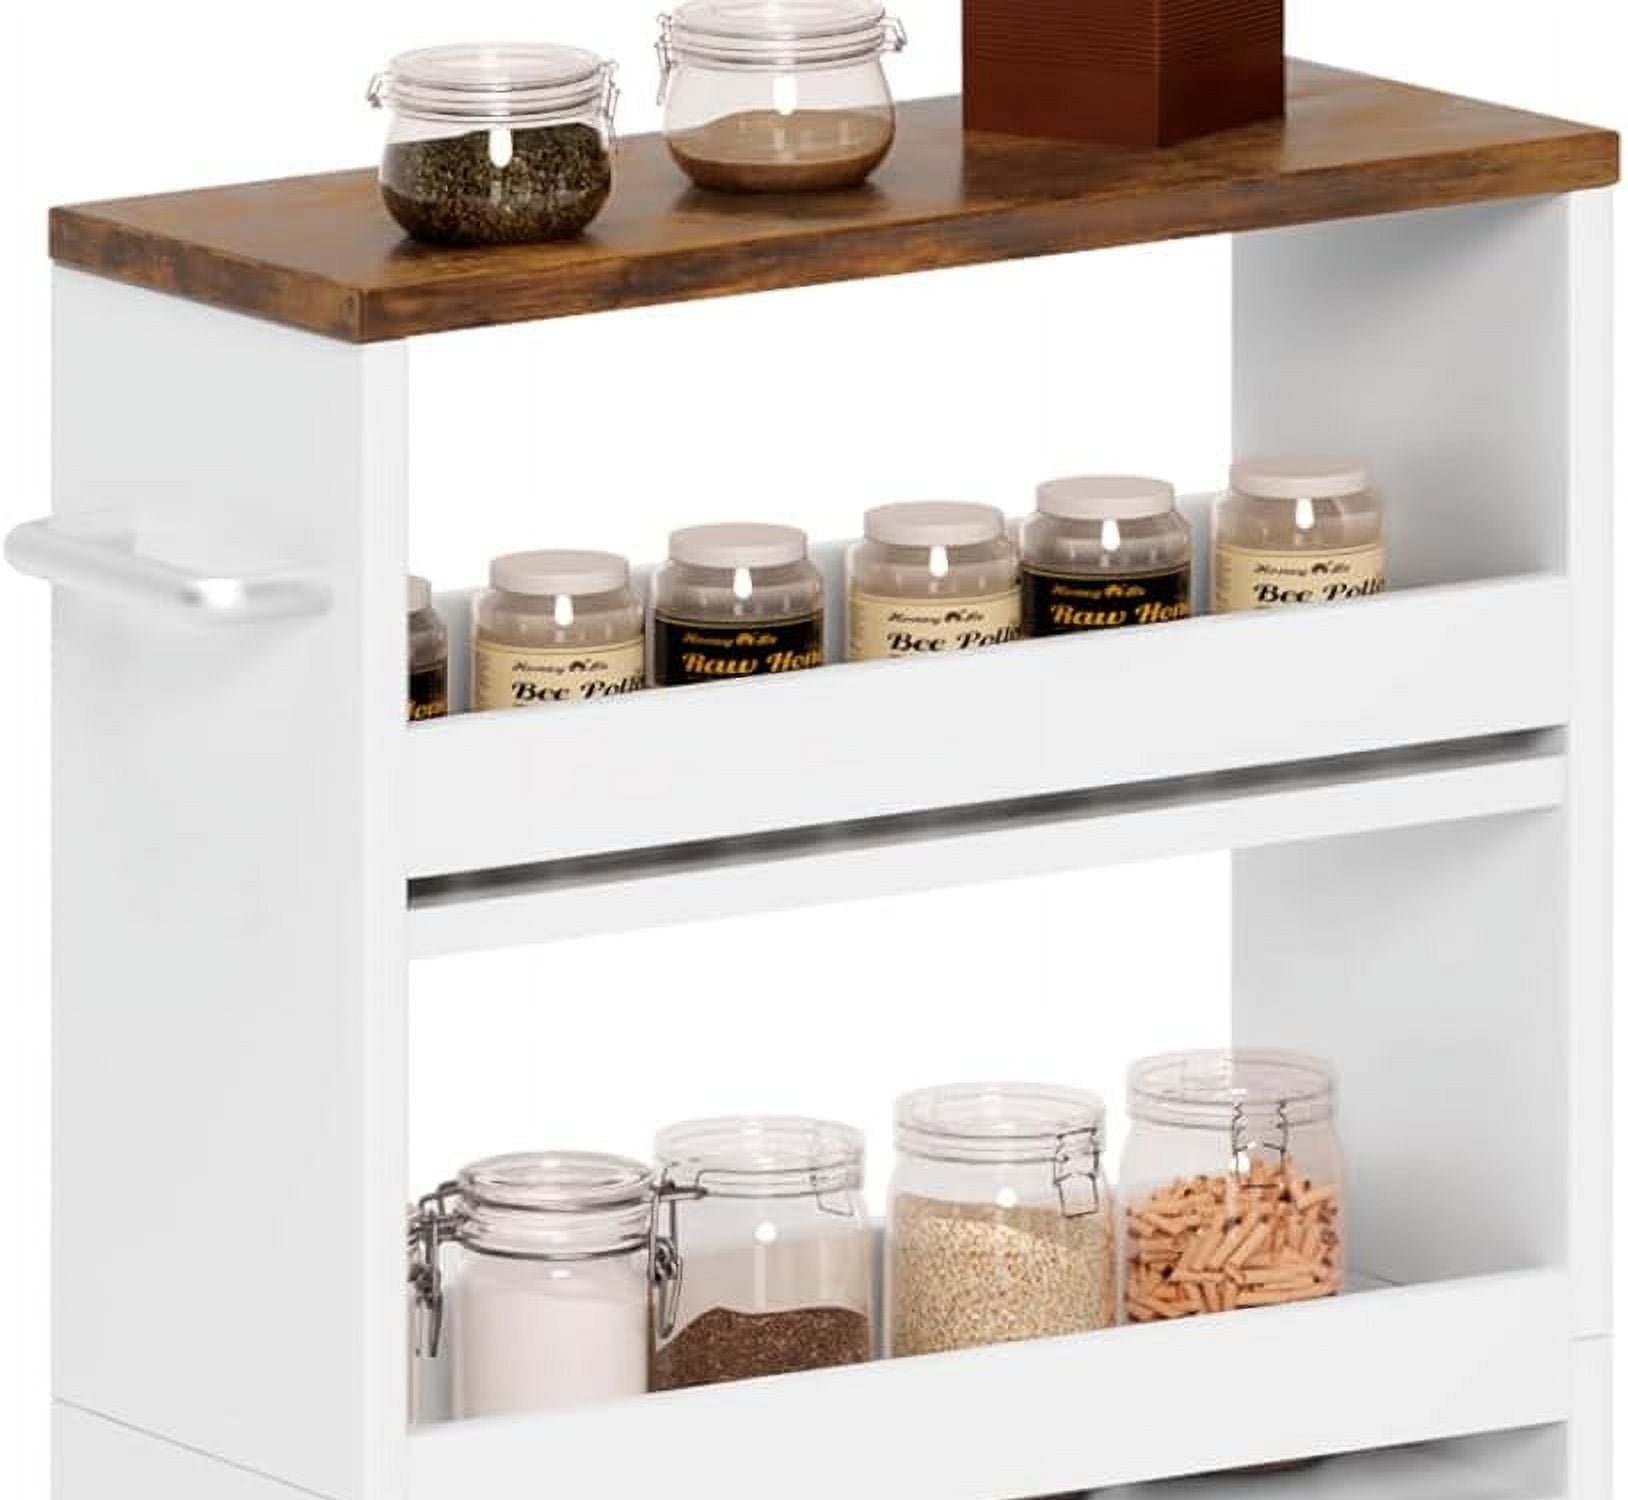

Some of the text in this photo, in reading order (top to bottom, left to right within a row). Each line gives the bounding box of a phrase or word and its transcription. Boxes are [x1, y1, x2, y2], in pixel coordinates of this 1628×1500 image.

[1253, 584, 1313, 602] Bee
[1050, 604, 1127, 625] Raw
[887, 633, 946, 652] Bee
[682, 653, 758, 674] Raw
[511, 681, 570, 701] Bee
